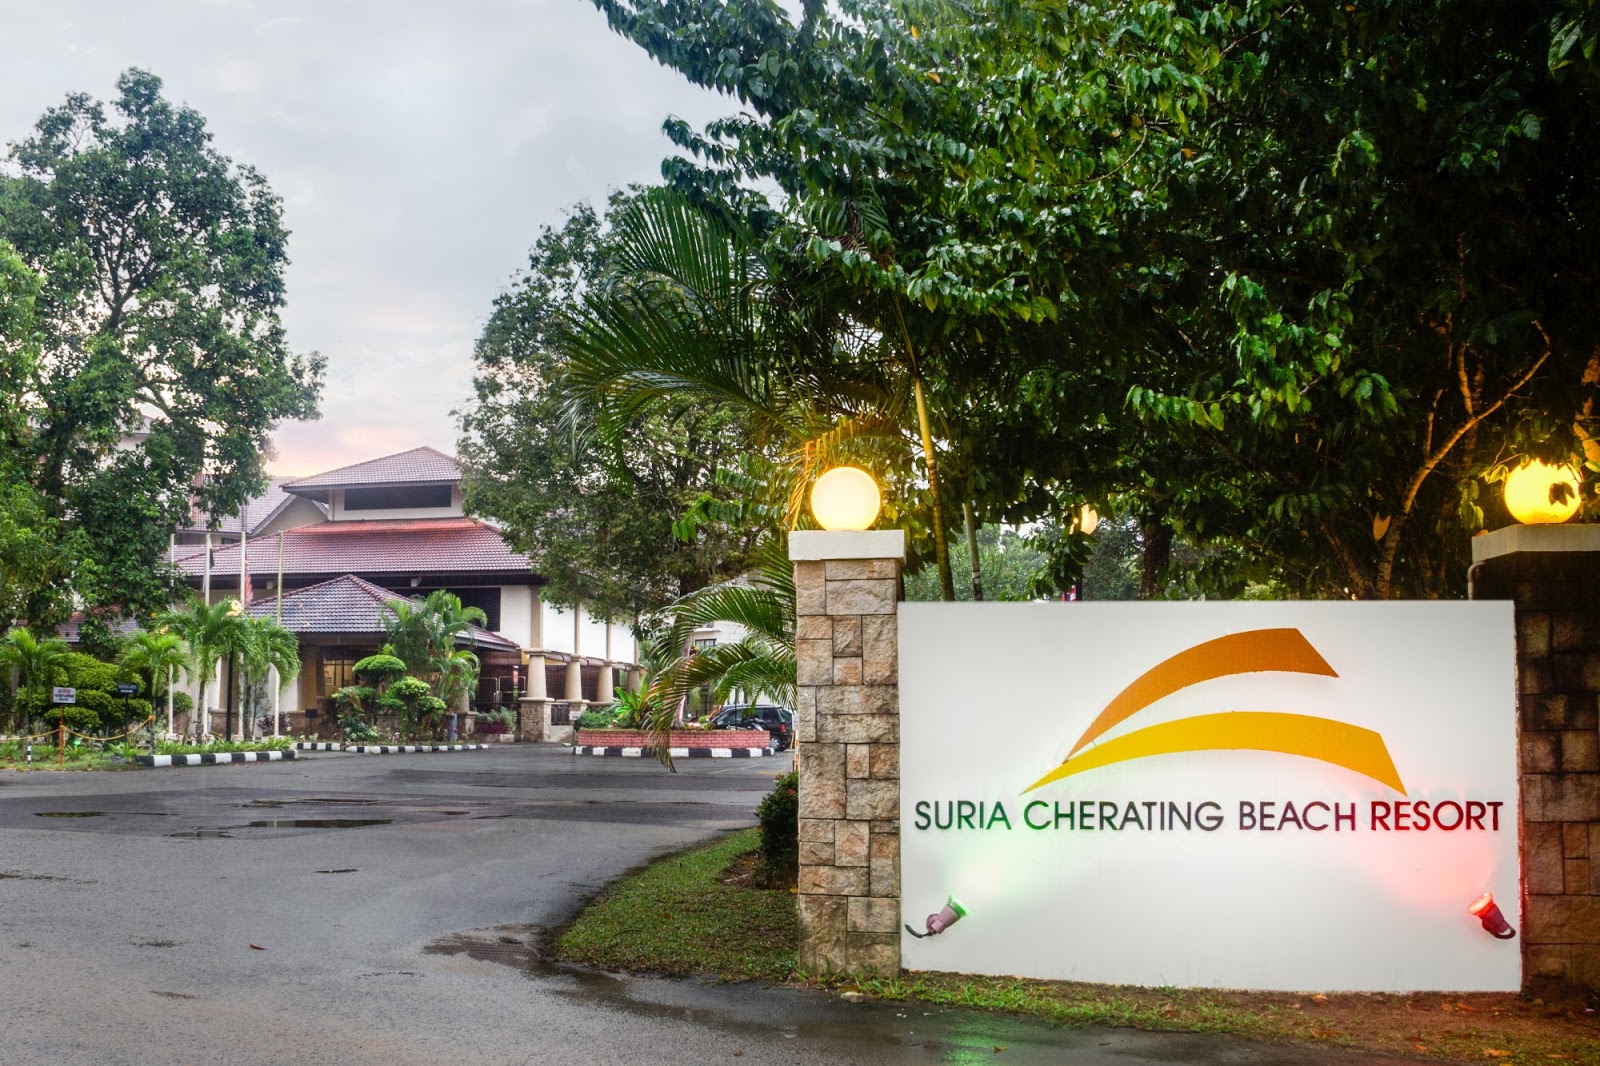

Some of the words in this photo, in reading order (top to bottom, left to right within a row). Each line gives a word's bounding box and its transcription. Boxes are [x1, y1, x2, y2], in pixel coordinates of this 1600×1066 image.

[914, 800, 1012, 830] SURIA
[1024, 800, 1224, 831] CHERATING
[1239, 801, 1356, 831] BEACH
[1370, 800, 1504, 831] RESORT
